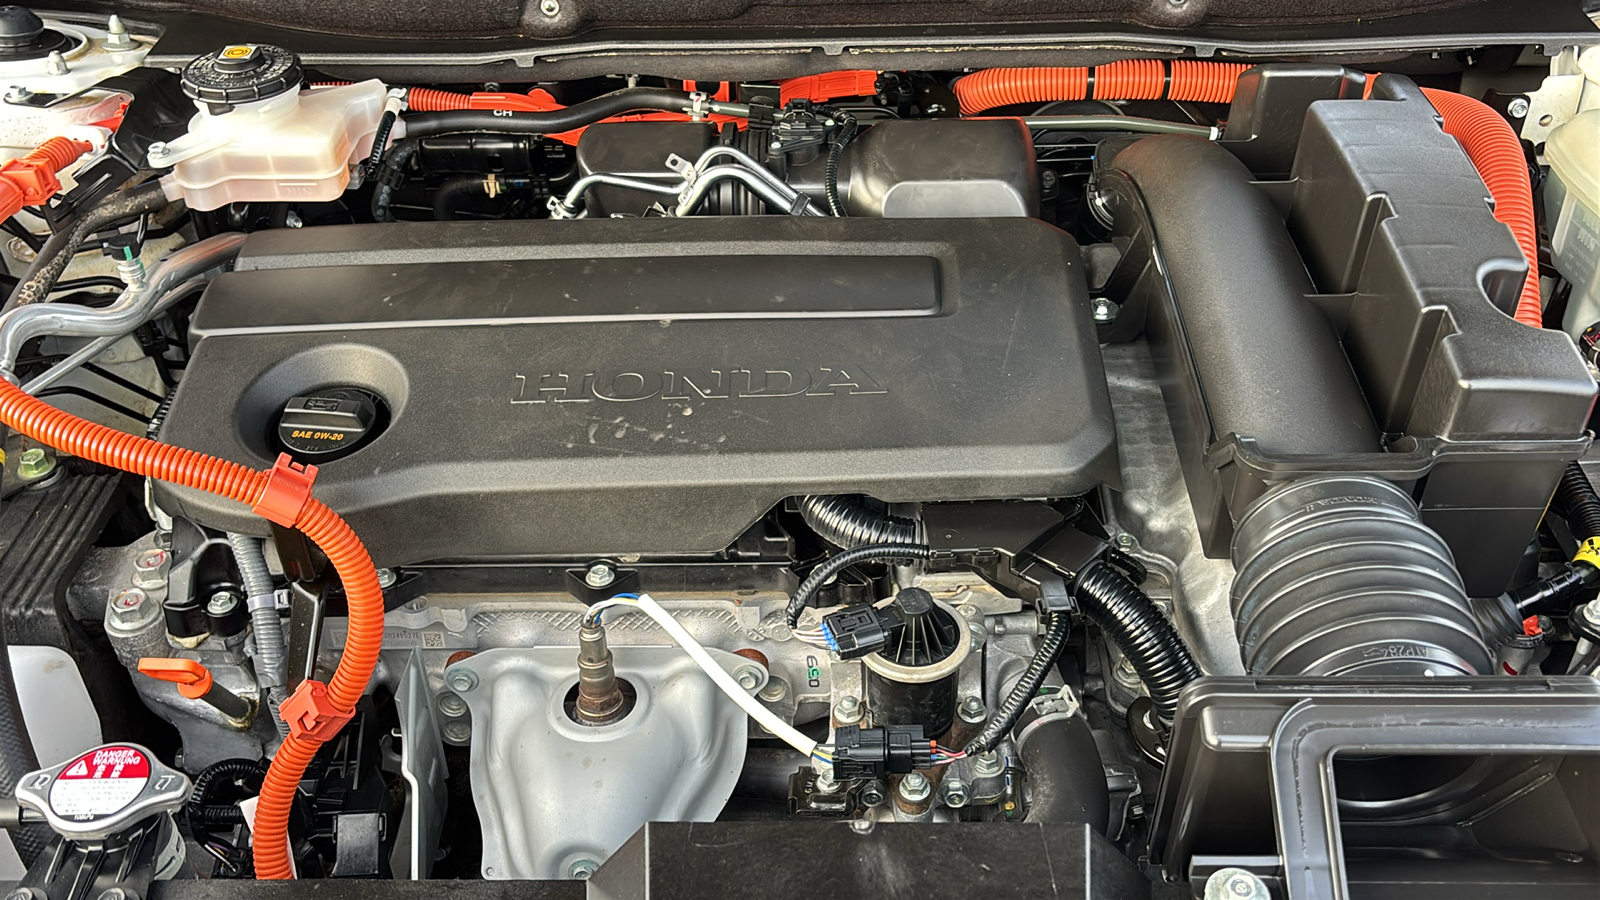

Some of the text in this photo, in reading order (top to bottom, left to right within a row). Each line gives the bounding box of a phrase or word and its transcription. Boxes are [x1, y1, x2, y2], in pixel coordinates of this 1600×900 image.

[493, 109, 513, 117] CH
[286, 187, 312, 197] MIN
[510, 365, 889, 404] HONDA
[291, 430, 344, 441] SAE 0W-20
[95, 750, 135, 758] DANGER
[92, 756, 140, 765] WARNUNG
